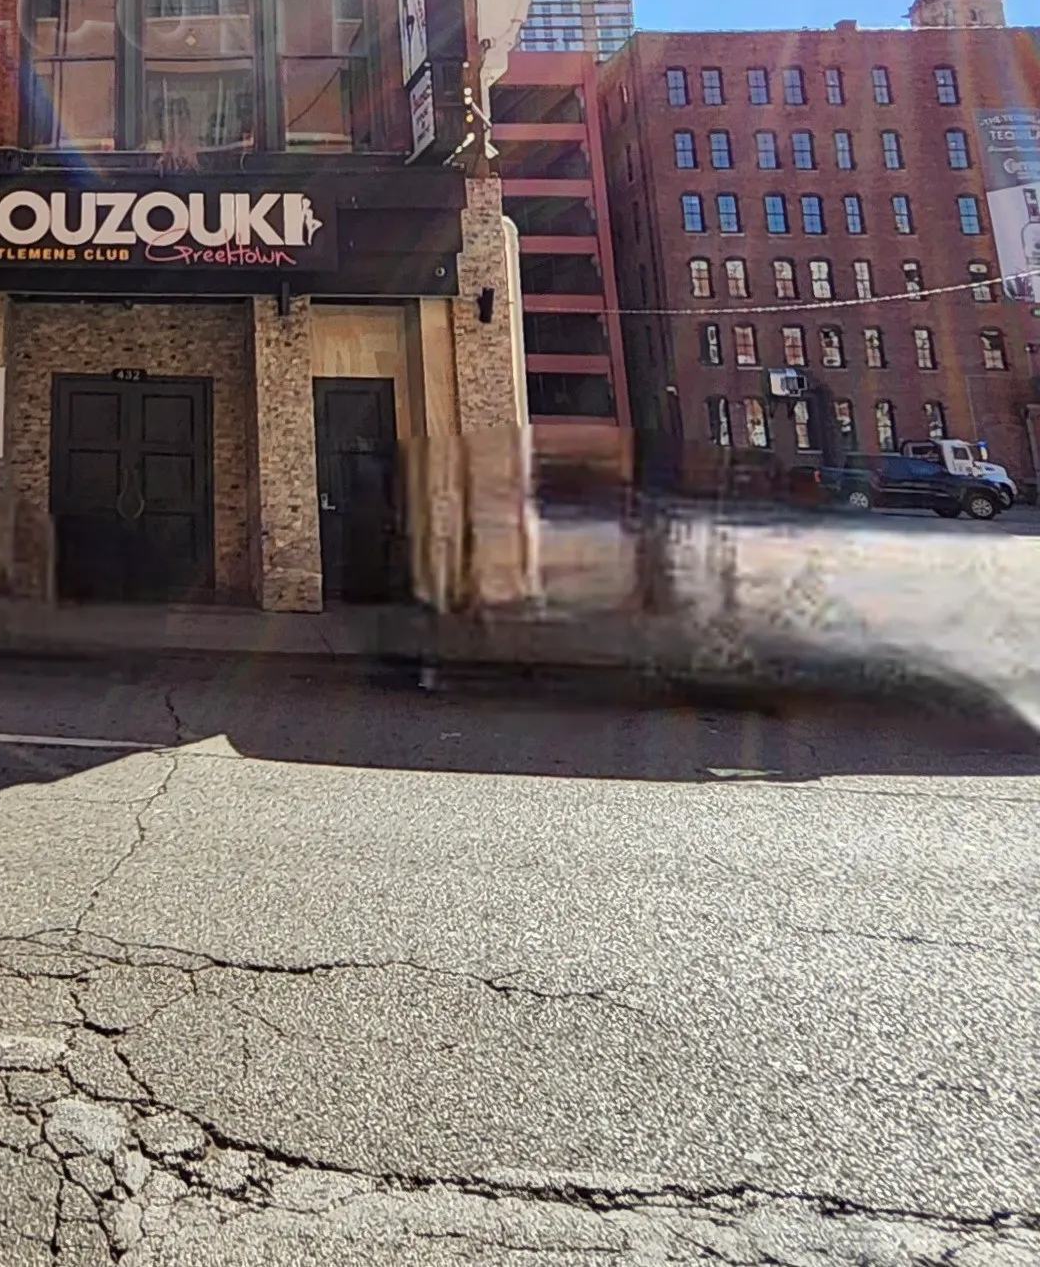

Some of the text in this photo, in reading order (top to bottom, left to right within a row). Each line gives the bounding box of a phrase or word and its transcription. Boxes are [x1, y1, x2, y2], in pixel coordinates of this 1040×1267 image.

[144, 228, 297, 266] Greektown
[83, 248, 130, 262] CLUB
[116, 369, 141, 382] 432
